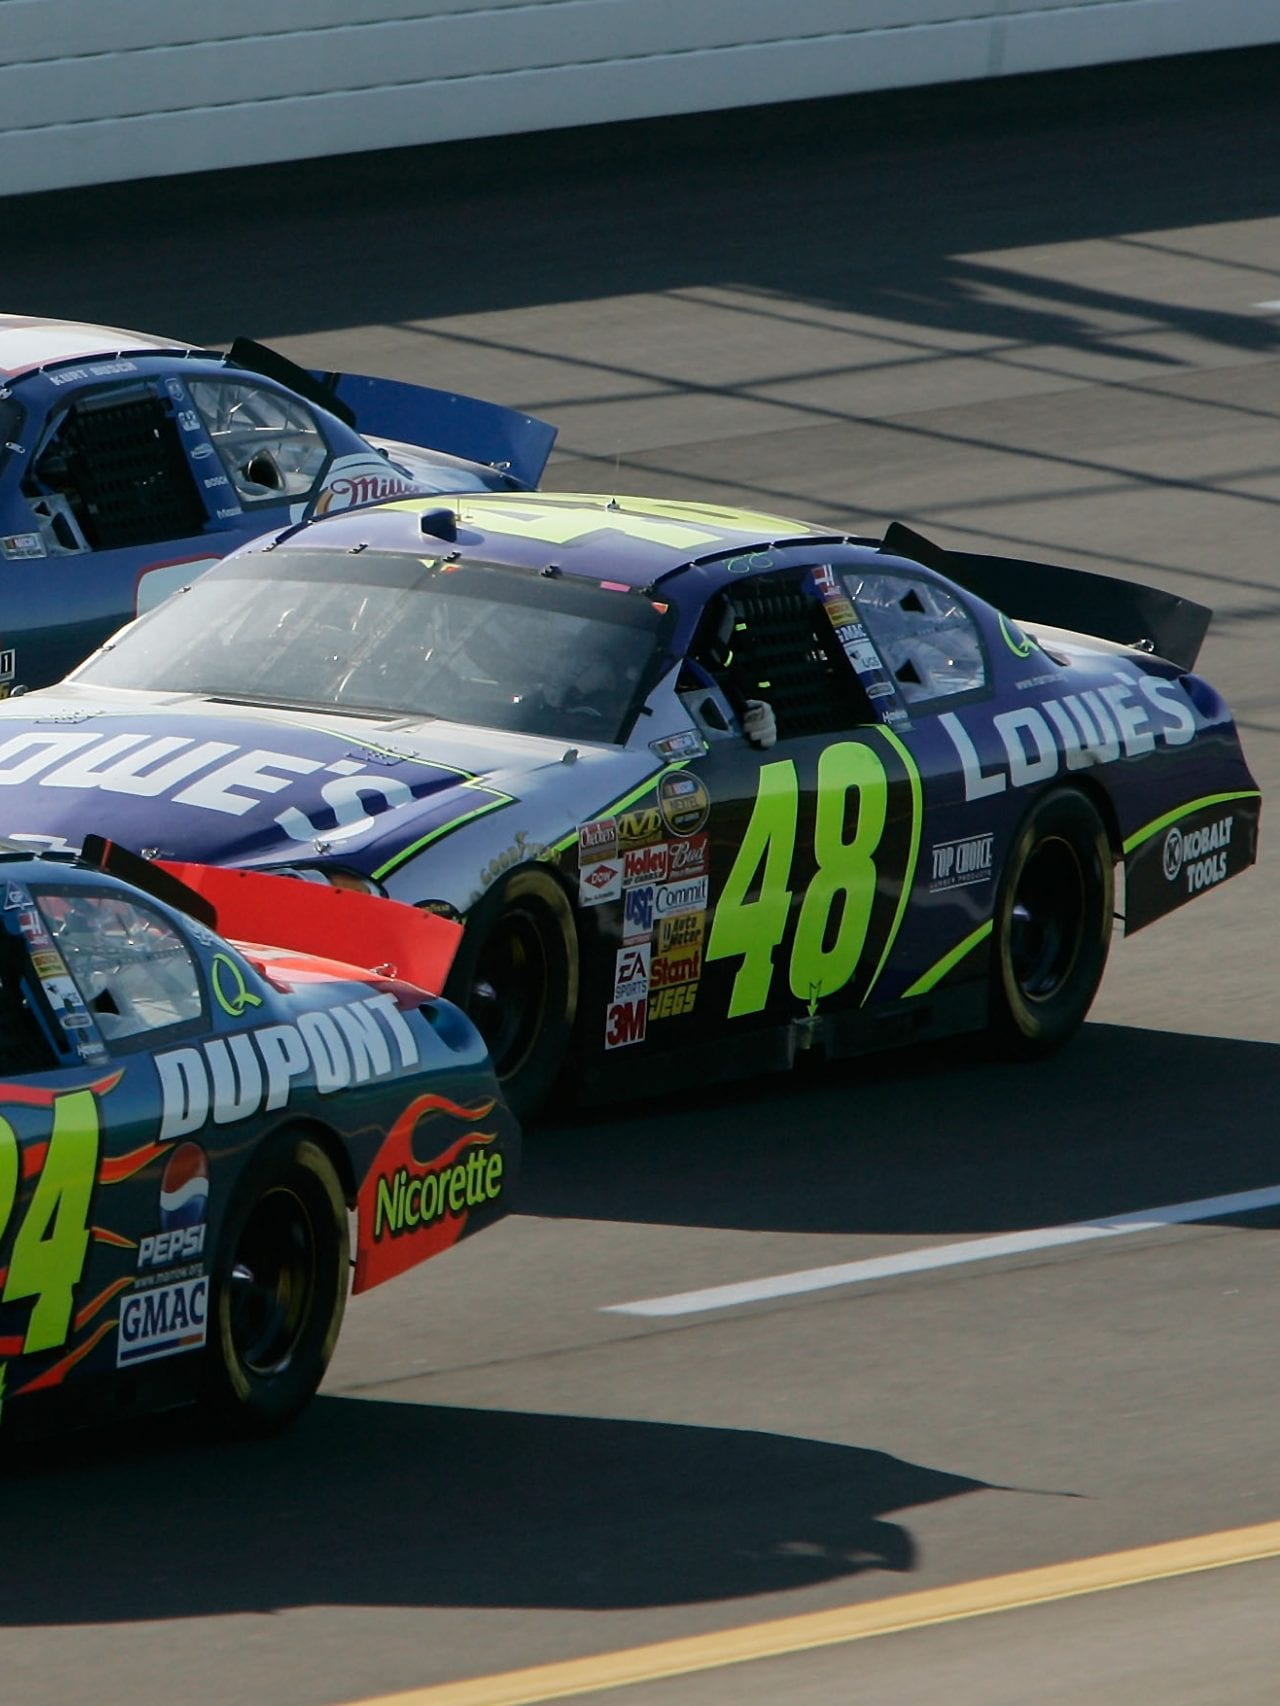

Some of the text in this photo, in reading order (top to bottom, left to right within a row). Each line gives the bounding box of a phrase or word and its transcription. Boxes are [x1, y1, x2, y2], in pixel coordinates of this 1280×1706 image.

[938, 674, 1196, 802] LOWE'S
[670, 838, 708, 872] Bud
[932, 837, 994, 880] TOP CHOICE
[1183, 815, 1234, 862] KOBALT
[624, 849, 668, 879] Holley
[704, 741, 888, 1020] 48
[1187, 851, 1228, 893] TOOLS
[626, 886, 654, 931] USG
[656, 883, 707, 913] Commit
[615, 980, 648, 1000] SPORTS
[617, 951, 647, 986] EA
[650, 953, 701, 990] Stant
[607, 999, 647, 1047] 3M
[650, 983, 699, 1021] JEGS
[153, 993, 420, 1141] DUPONT
[374, 1149, 505, 1237] Nicorette
[136, 1223, 207, 1268] PEPSI
[122, 1281, 206, 1342] GMAC
